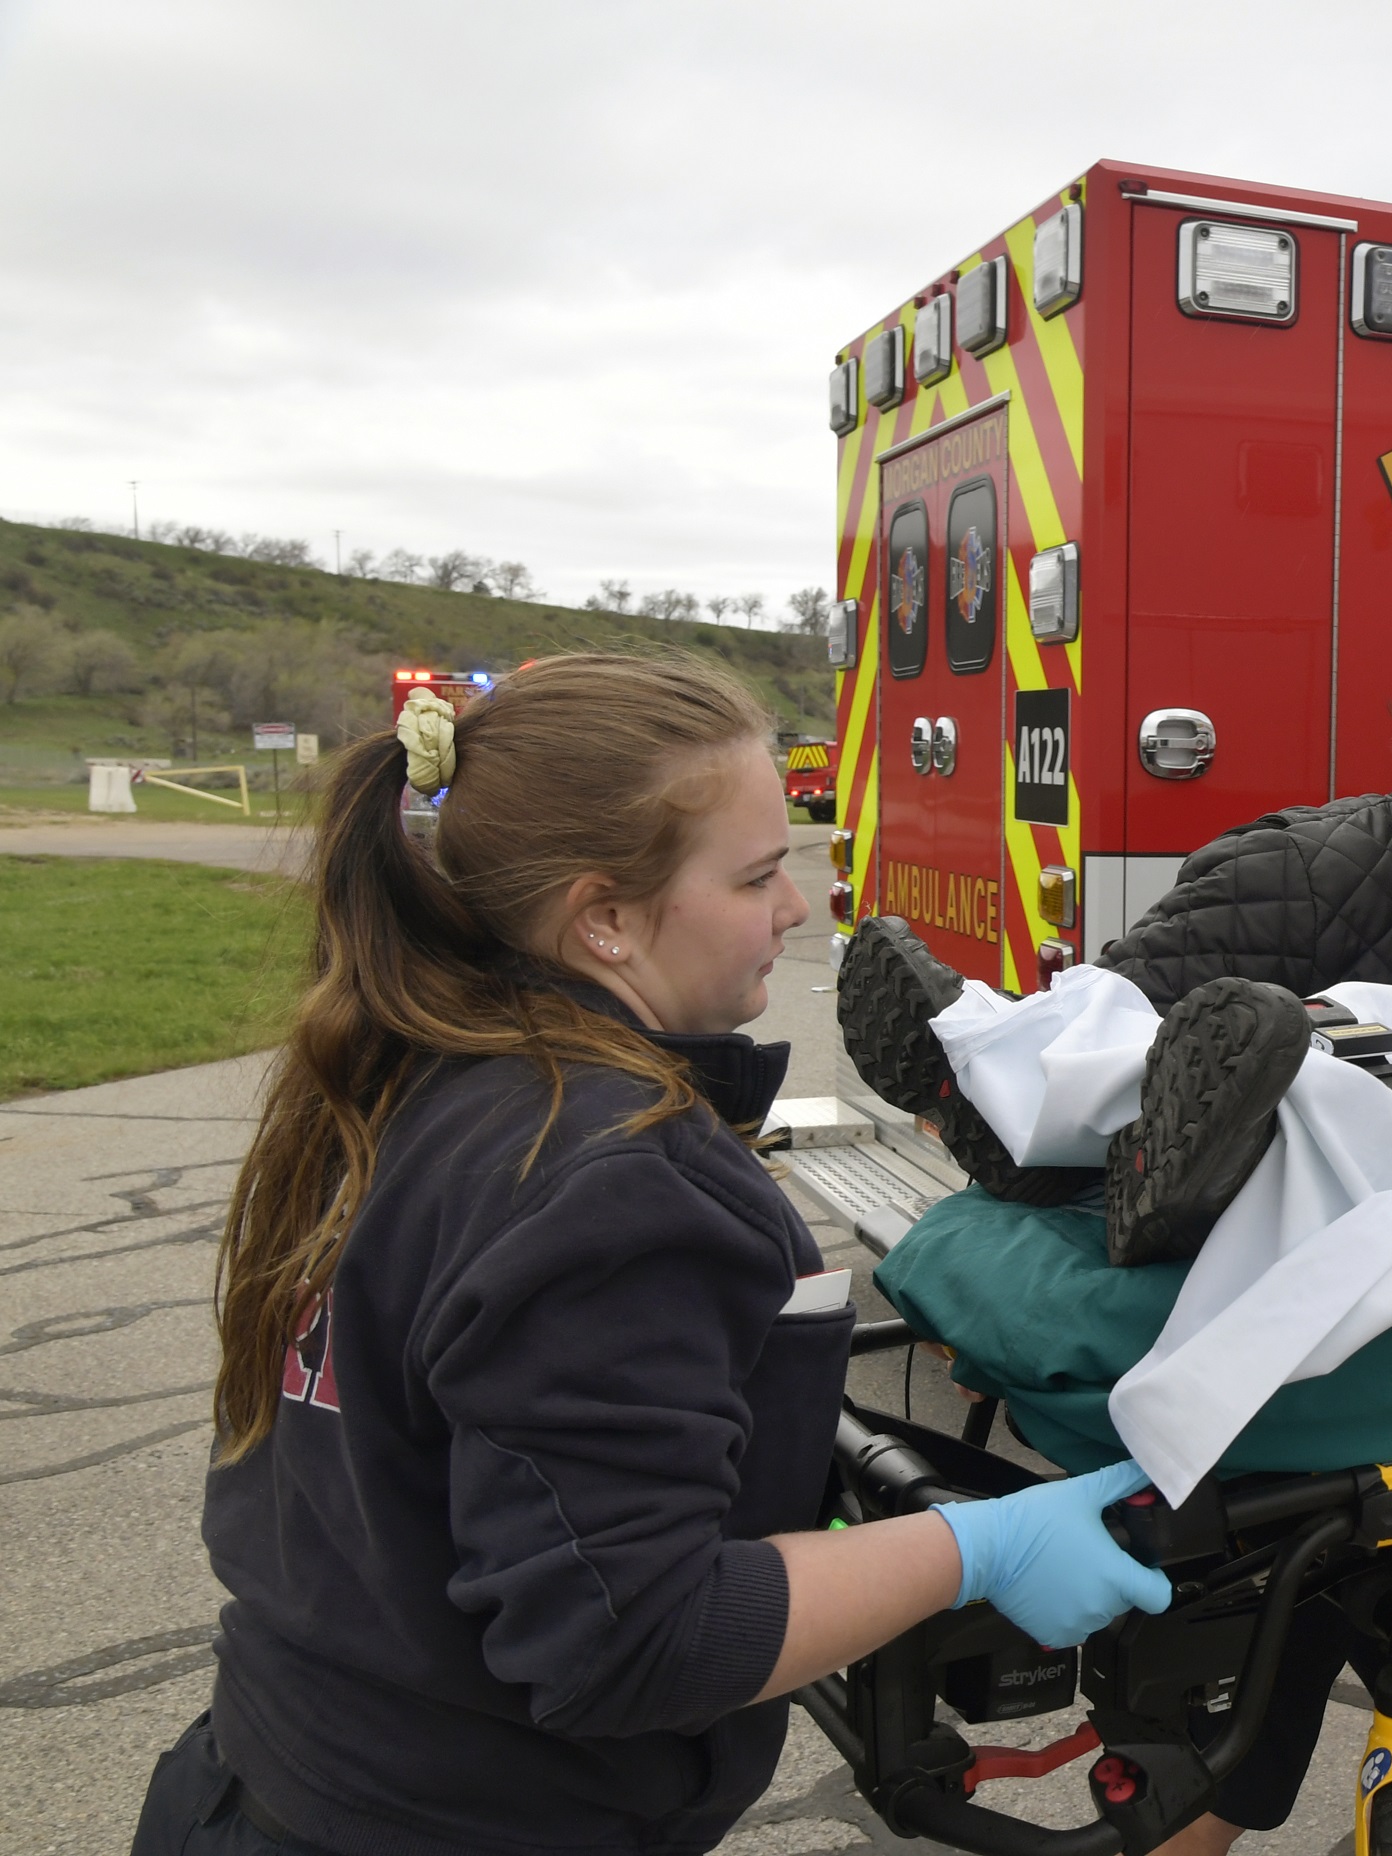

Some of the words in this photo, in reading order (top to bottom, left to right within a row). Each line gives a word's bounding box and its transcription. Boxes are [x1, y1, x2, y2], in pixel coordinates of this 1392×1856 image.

[884, 445, 939, 503] MORGAN
[942, 414, 1004, 480] COUNTY
[1018, 726, 1065, 785] A122
[885, 860, 998, 944] AMBULANCE
[998, 1664, 1066, 1687] stryker
